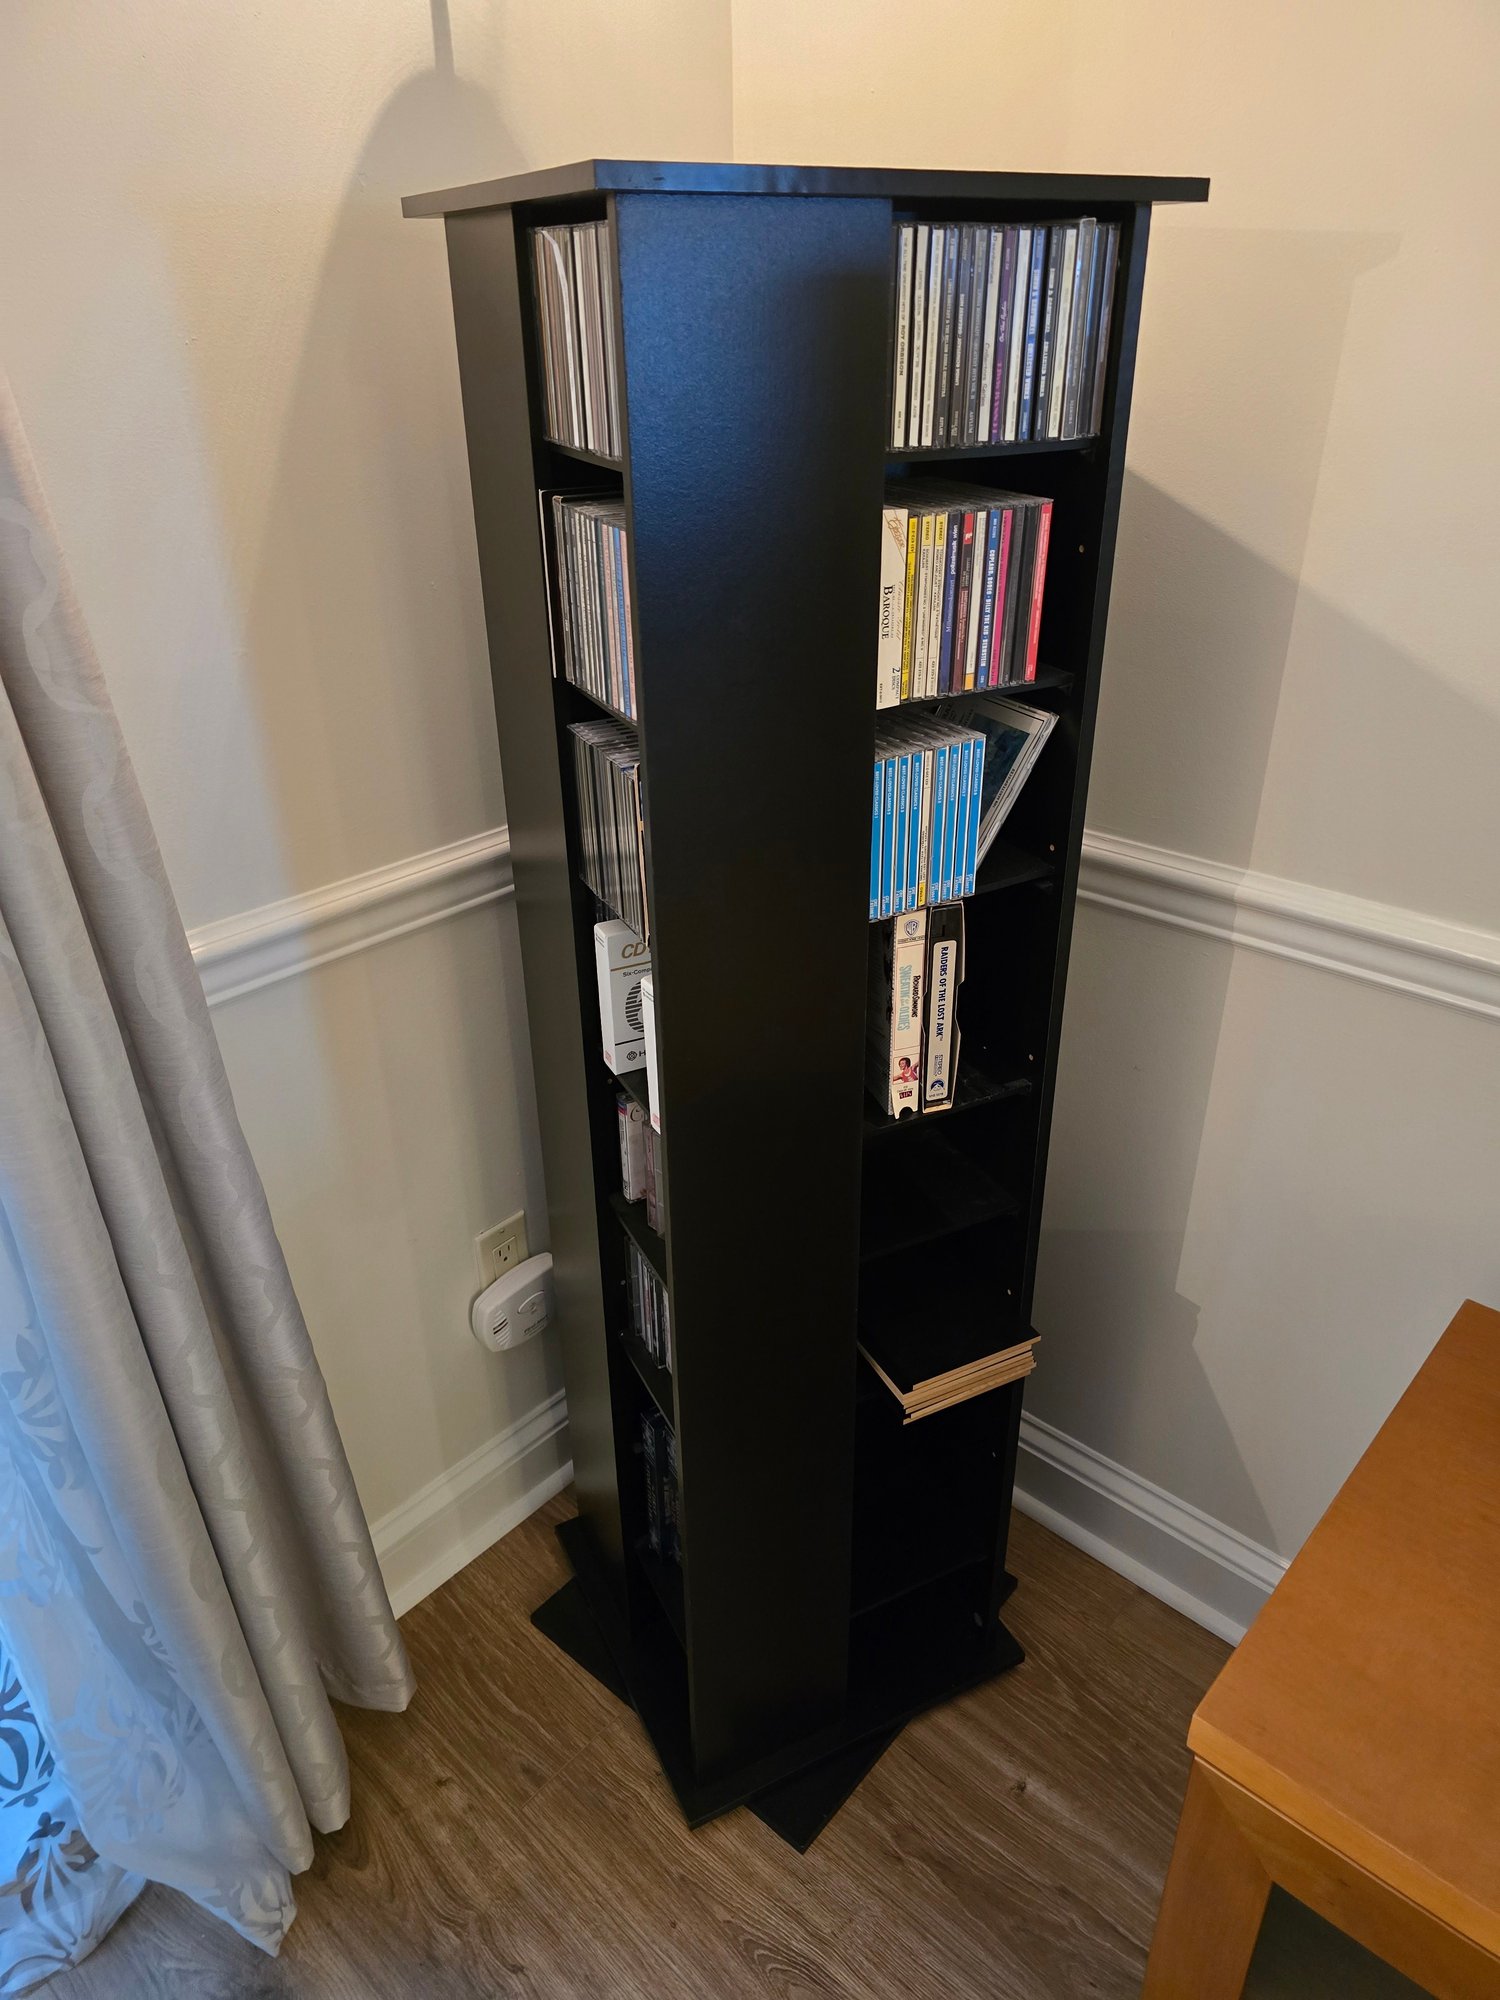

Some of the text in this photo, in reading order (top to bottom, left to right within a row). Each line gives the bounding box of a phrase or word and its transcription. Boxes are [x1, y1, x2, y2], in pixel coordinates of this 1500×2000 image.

[950, 540, 959, 576] polizeimusik
[882, 586, 894, 640] BAROQUE
[622, 942, 647, 959] CD
[940, 946, 949, 977] RAIDERS
[622, 967, 652, 978] Six-Comp
[940, 978, 947, 988] OF
[939, 989, 947, 1003] THE
[897, 1005, 911, 1034] OLDIES
[938, 1004, 946, 1022] LOST
